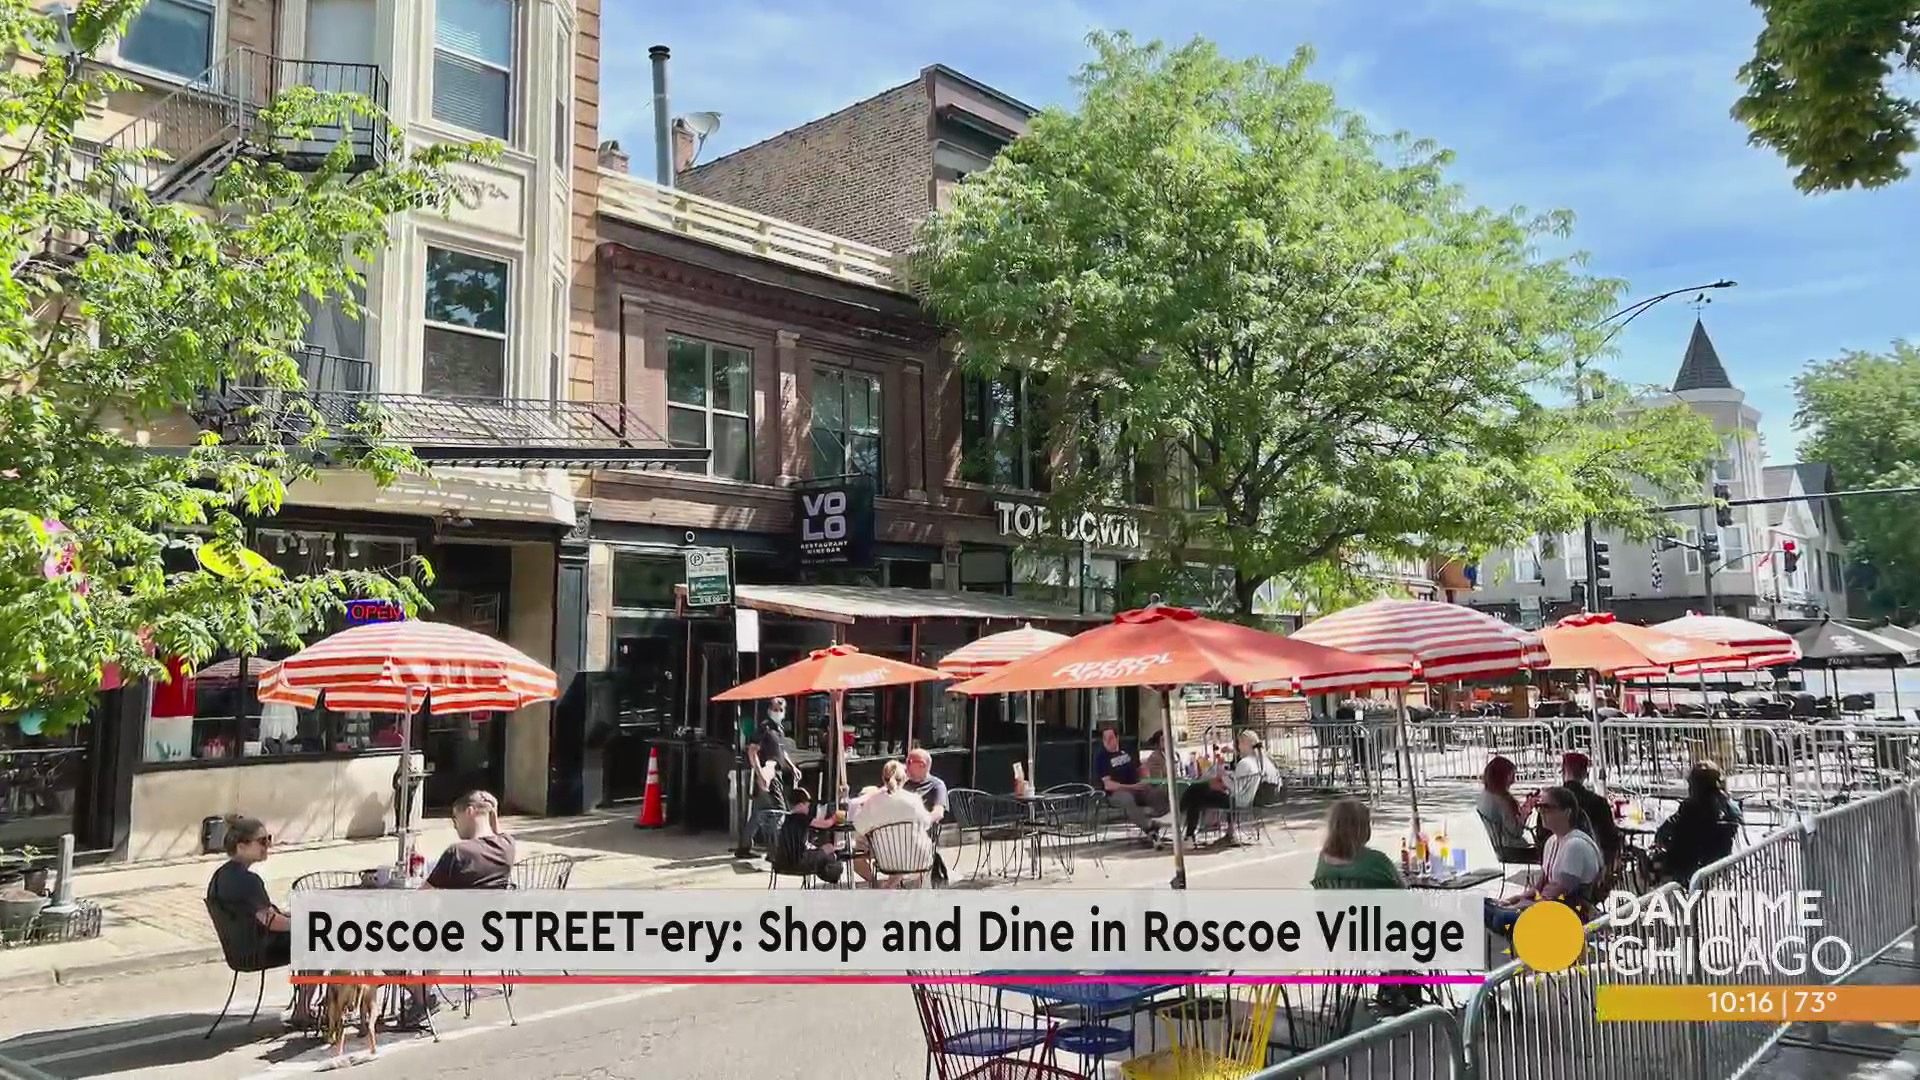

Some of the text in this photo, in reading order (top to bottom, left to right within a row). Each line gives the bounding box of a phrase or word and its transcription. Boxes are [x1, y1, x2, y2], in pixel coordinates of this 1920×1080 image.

[802, 491, 847, 516] VO
[802, 515, 847, 541] LO
[800, 541, 849, 550] RESTAURANT
[351, 604, 401, 619] OPEN
[1052, 652, 1174, 677] APEROL
